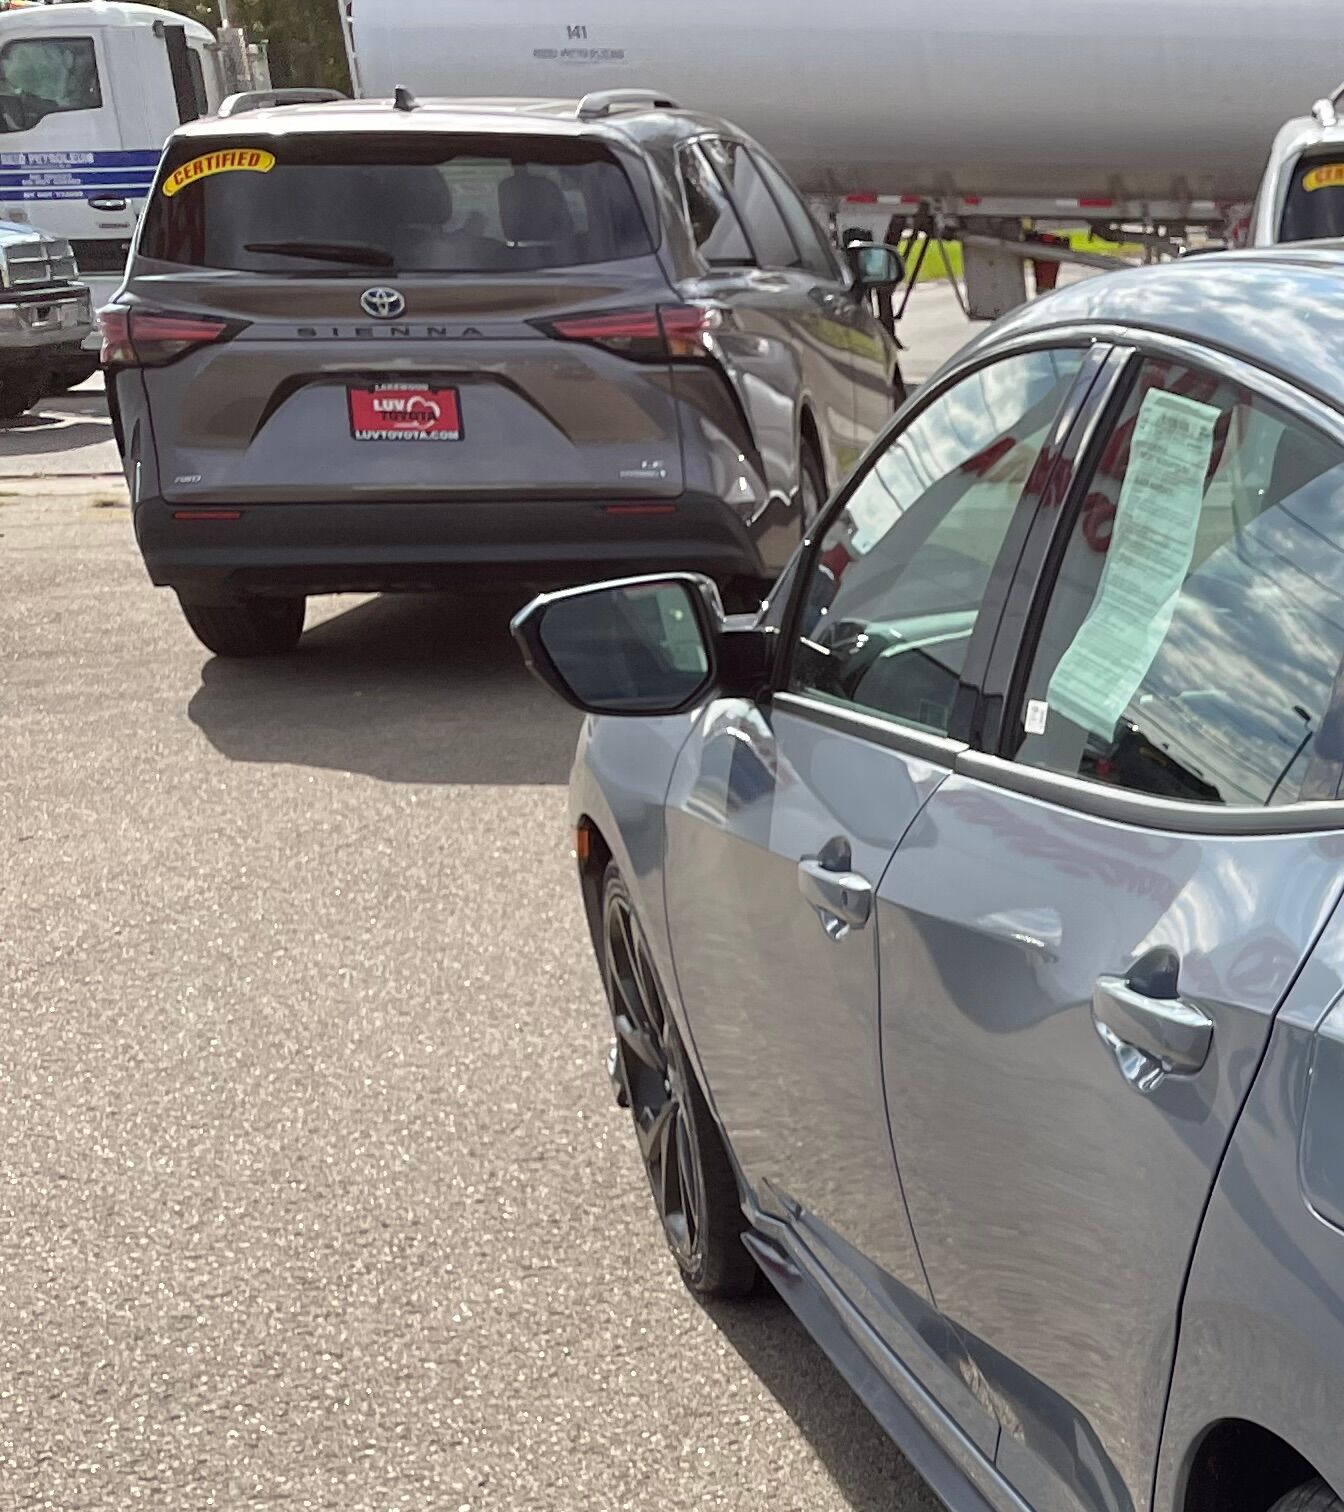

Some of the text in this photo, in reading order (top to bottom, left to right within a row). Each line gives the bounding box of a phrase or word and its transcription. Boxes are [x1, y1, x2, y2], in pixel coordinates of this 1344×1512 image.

[173, 151, 261, 185] CERTIFIED
[297, 327, 484, 337] SIENNA
[373, 399, 405, 412] LUV
[355, 430, 459, 440] LUVTOYOTA.COM
